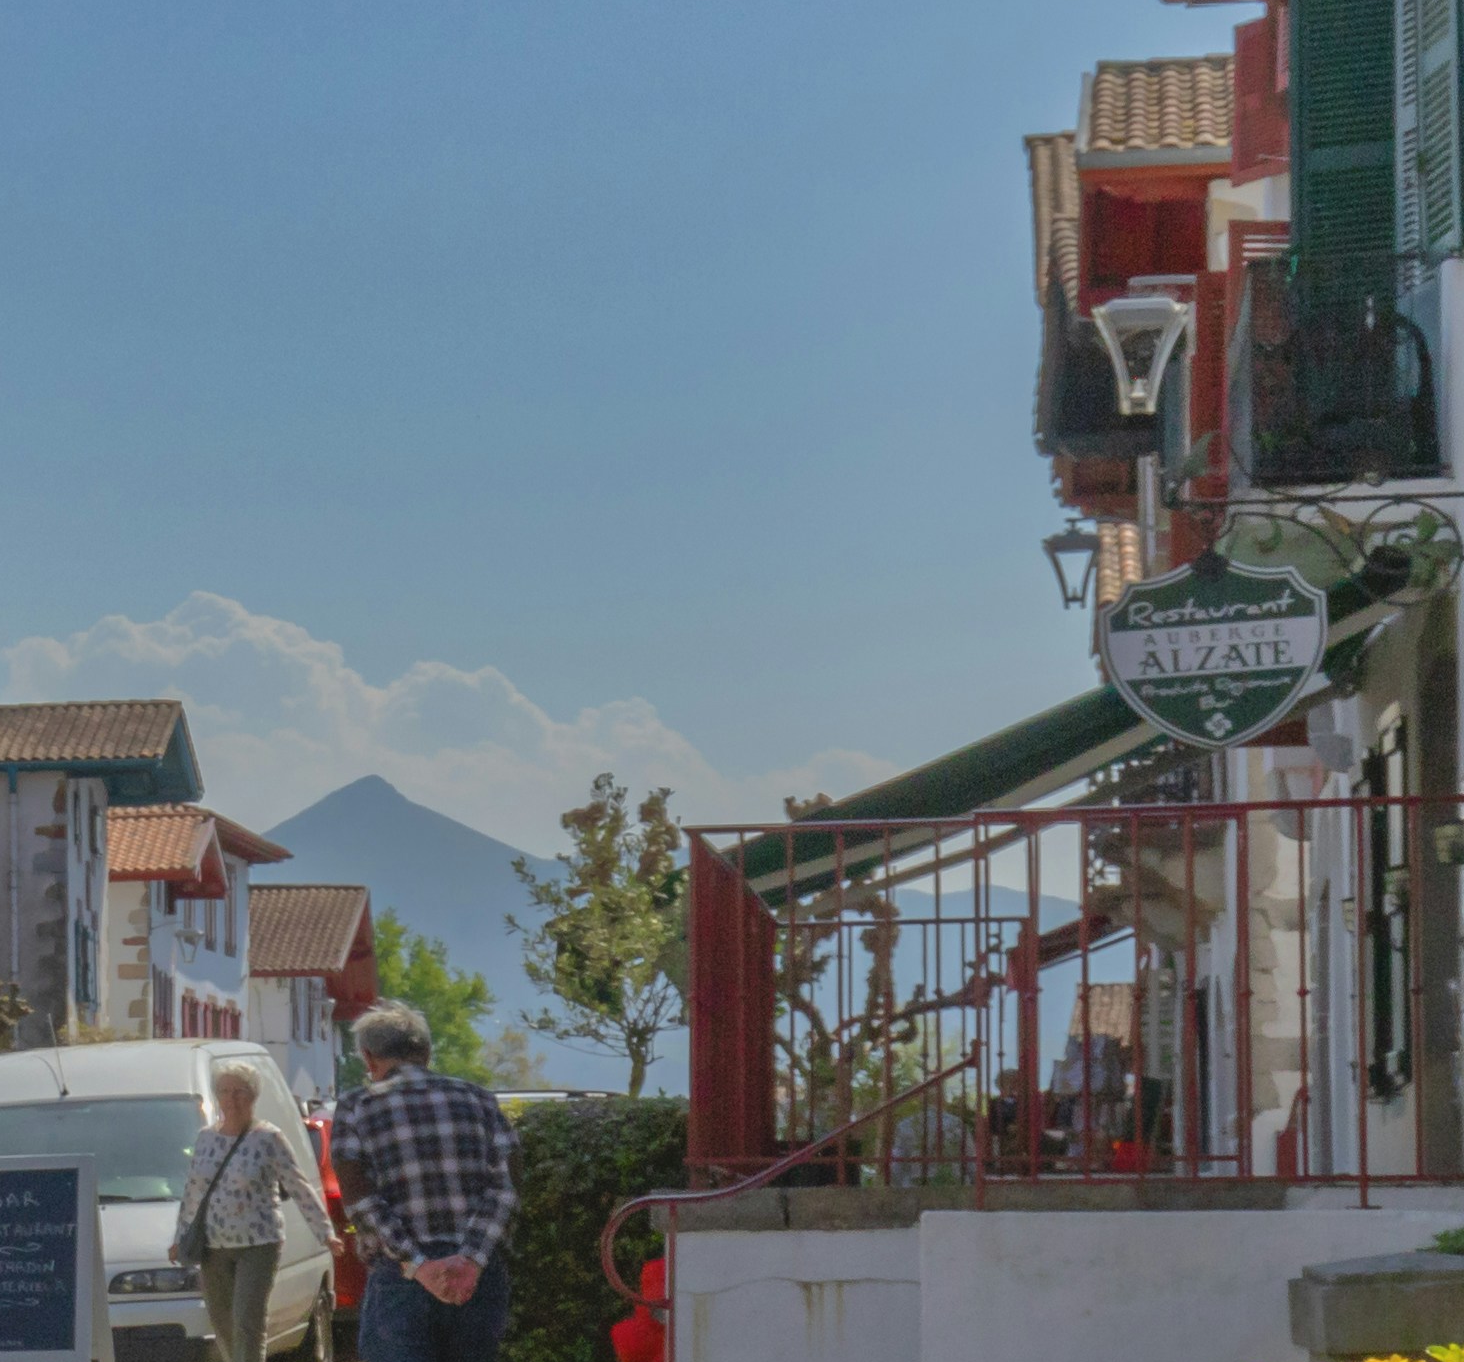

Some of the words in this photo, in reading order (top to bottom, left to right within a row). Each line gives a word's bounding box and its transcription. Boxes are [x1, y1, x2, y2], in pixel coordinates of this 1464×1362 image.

[1127, 589, 1295, 626] Restaurant
[1144, 623, 1287, 646] AUBERGE
[1138, 640, 1294, 675] ALZATE
